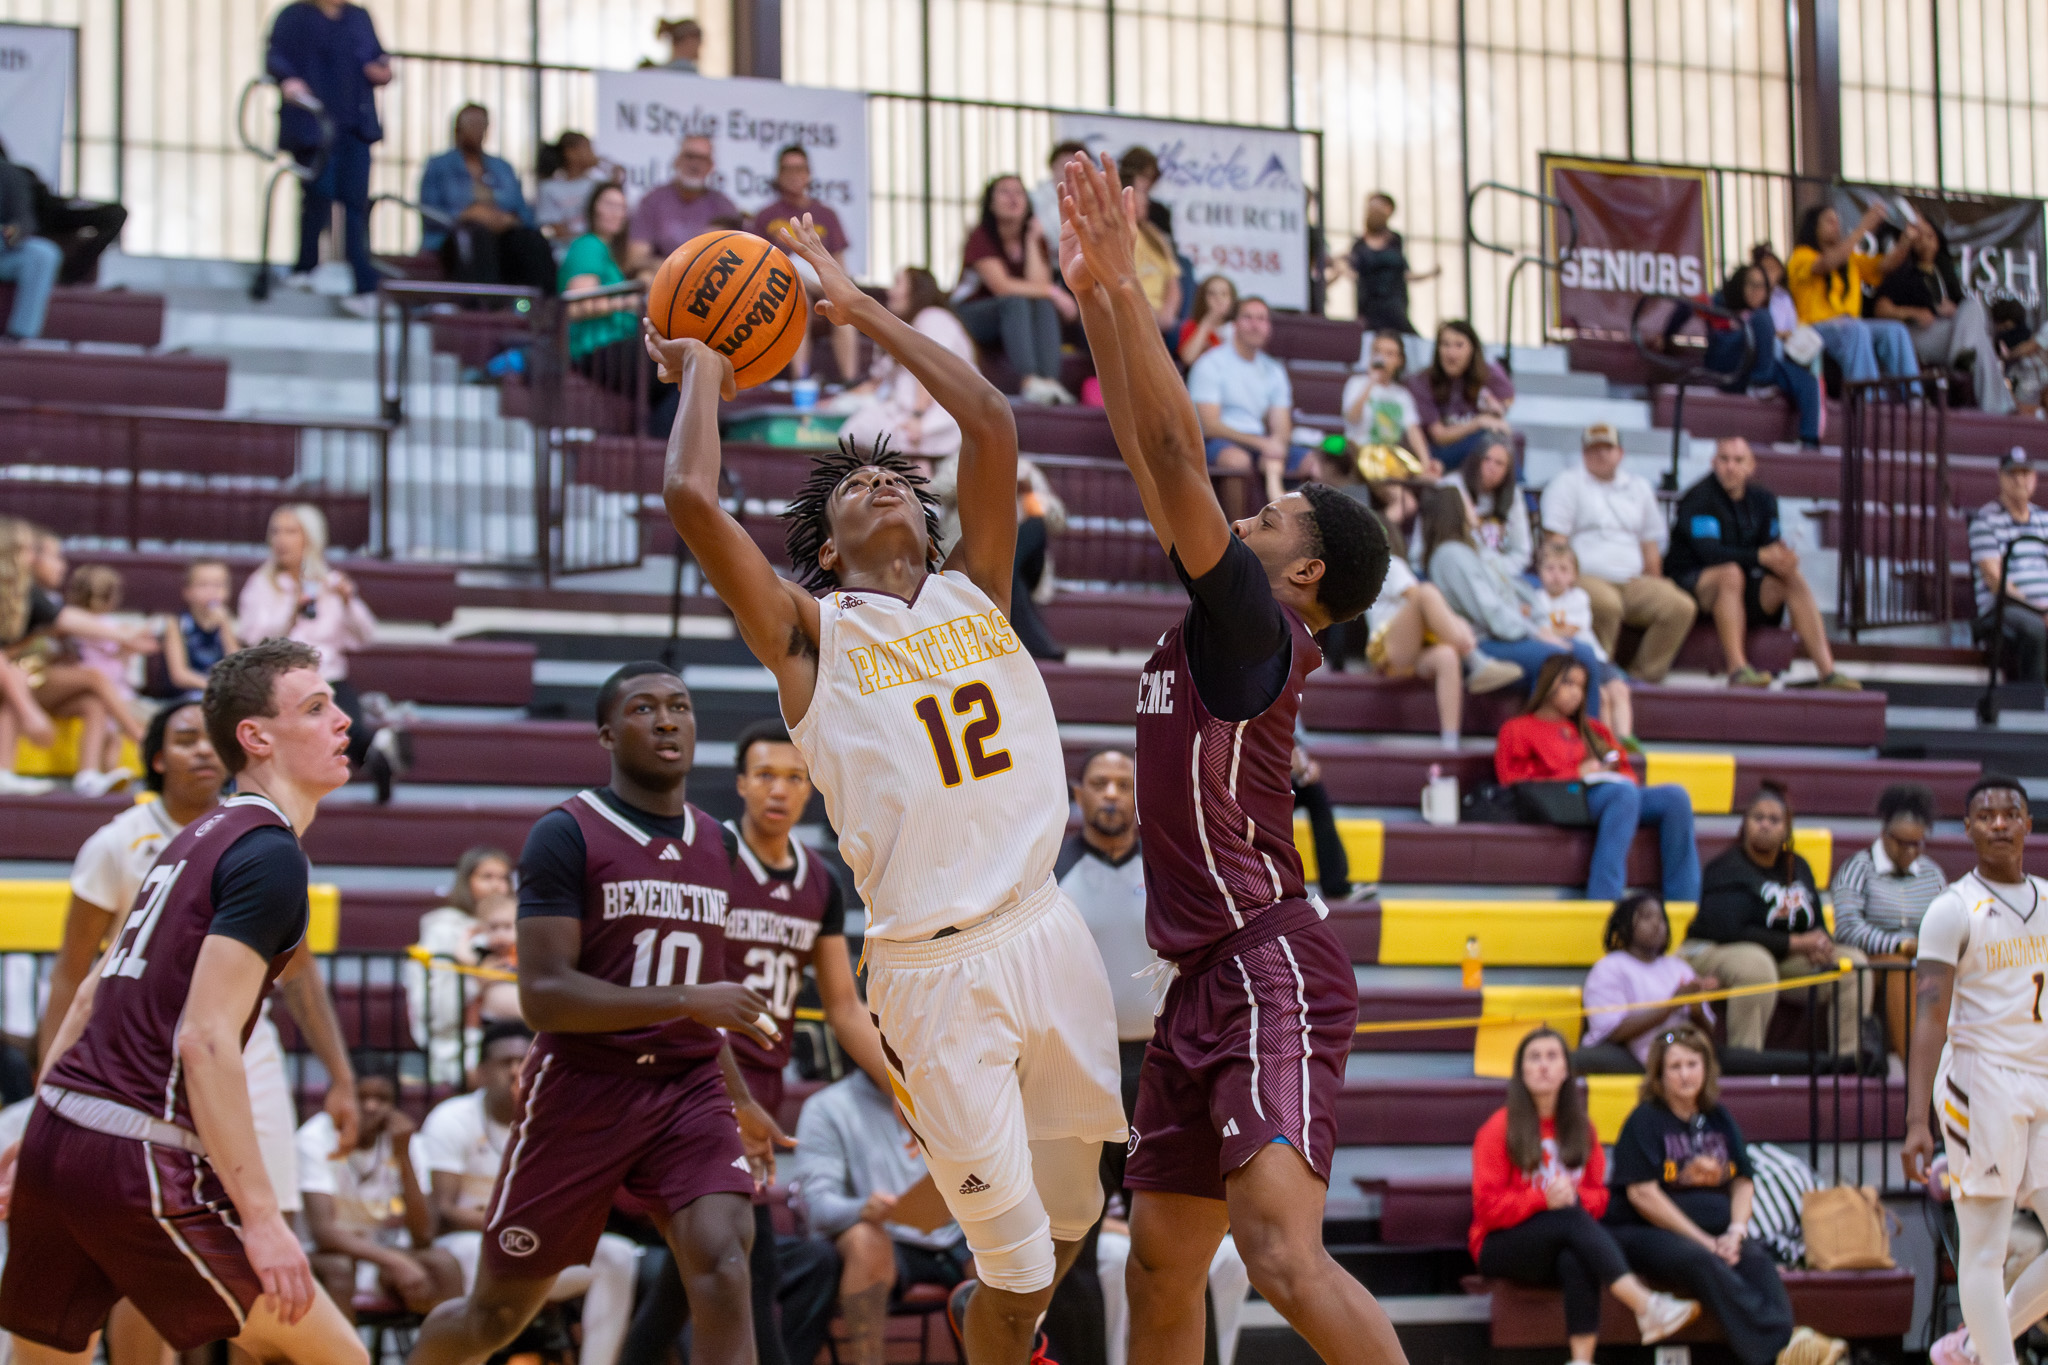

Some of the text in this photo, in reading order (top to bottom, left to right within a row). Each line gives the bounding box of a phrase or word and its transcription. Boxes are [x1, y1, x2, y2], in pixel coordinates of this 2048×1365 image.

[616, 101, 836, 150] N Style Express
[1186, 203, 1297, 233] CHURCH
[687, 249, 744, 319] NCAA
[1560, 246, 1702, 296] SENIORS
[717, 267, 792, 356] Wilson
[847, 607, 1021, 696] PANTHERS
[912, 679, 1013, 788] 12
[101, 859, 188, 979] 21
[602, 879, 728, 927] BENEDICTINE
[724, 907, 822, 952] BENEDICTIN
[630, 928, 703, 988] 10
[743, 947, 802, 1020] 20
[959, 1183, 991, 1195] adidas
